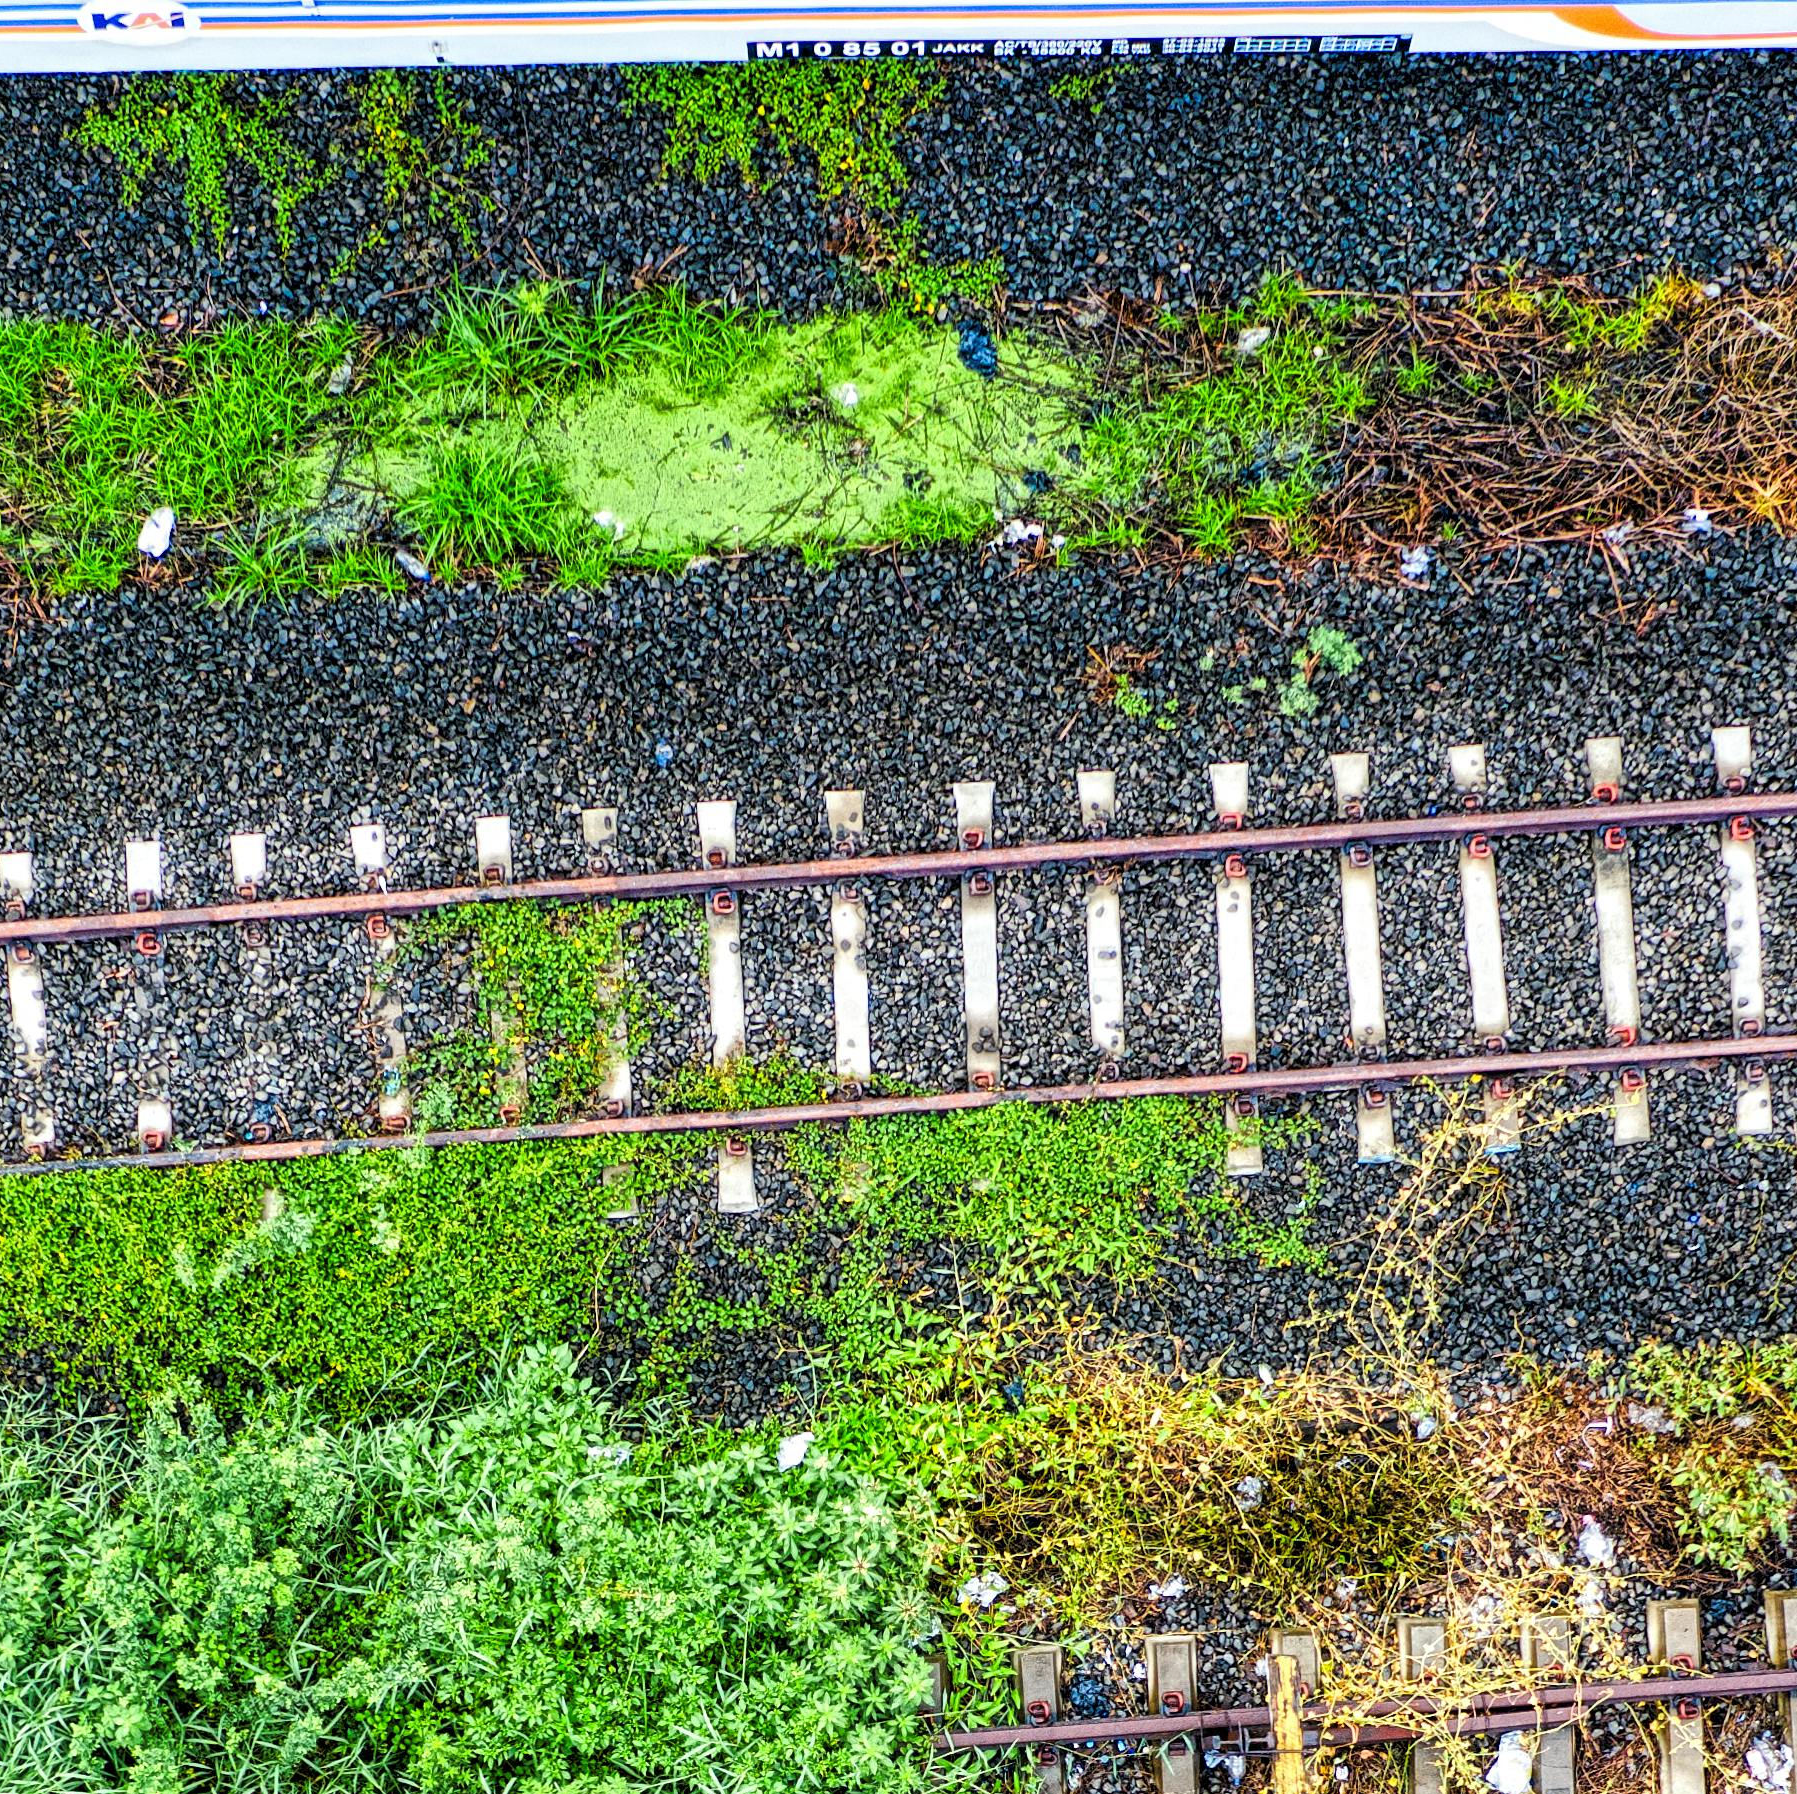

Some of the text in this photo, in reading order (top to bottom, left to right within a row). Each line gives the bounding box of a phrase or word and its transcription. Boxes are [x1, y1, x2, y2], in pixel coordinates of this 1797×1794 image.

[91, 12, 185, 30] KAI
[756, 41, 985, 58] M1 0 85 01 JAKK
